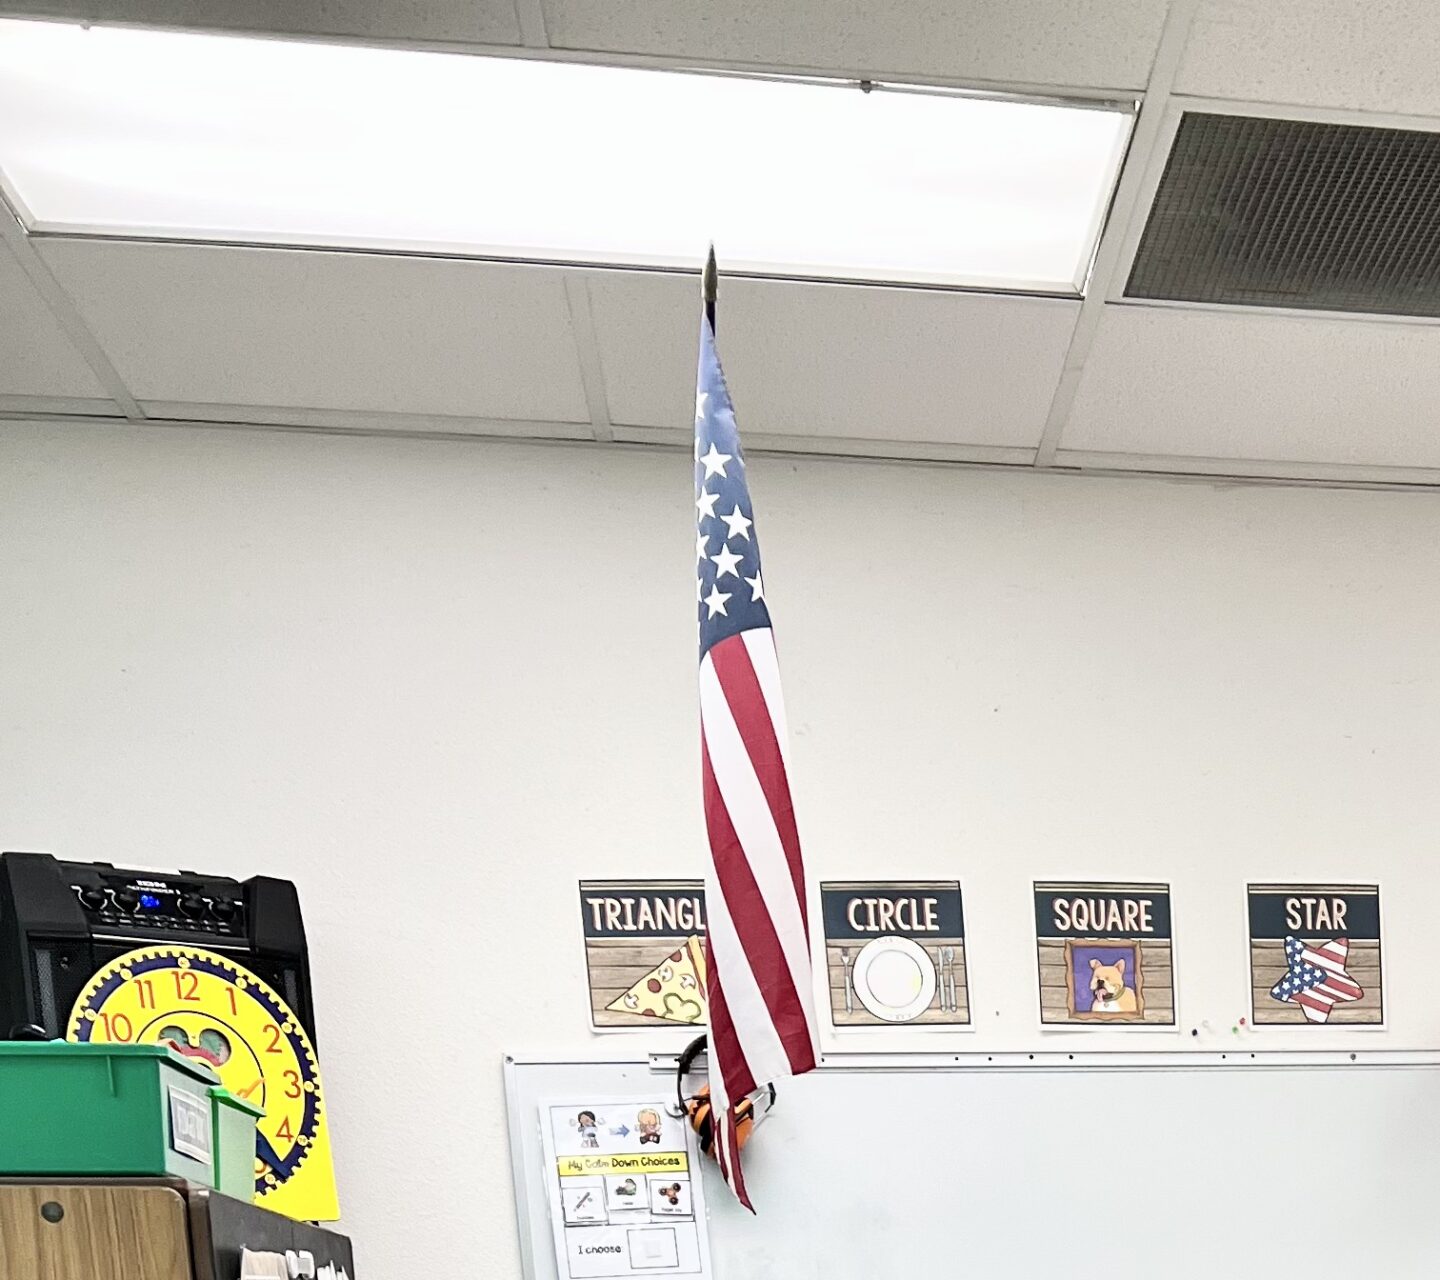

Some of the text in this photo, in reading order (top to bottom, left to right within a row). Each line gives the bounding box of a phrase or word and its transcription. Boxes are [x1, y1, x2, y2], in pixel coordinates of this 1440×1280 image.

[586, 897, 707, 931] TRIANGL
[846, 897, 939, 933] CIRCLE
[1053, 898, 1155, 933] SQUARE
[1285, 898, 1348, 931] STAR
[133, 980, 155, 1009] 11
[171, 970, 200, 1001] 12
[225, 987, 237, 1016] 1
[99, 1013, 132, 1042] 10
[263, 1024, 282, 1053] 2
[283, 1070, 301, 1098] 3
[275, 1116, 294, 1143] 4
[611, 1157, 639, 1168] Down
[640, 1156, 681, 1167] Choices
[585, 1245, 622, 1254] choose
